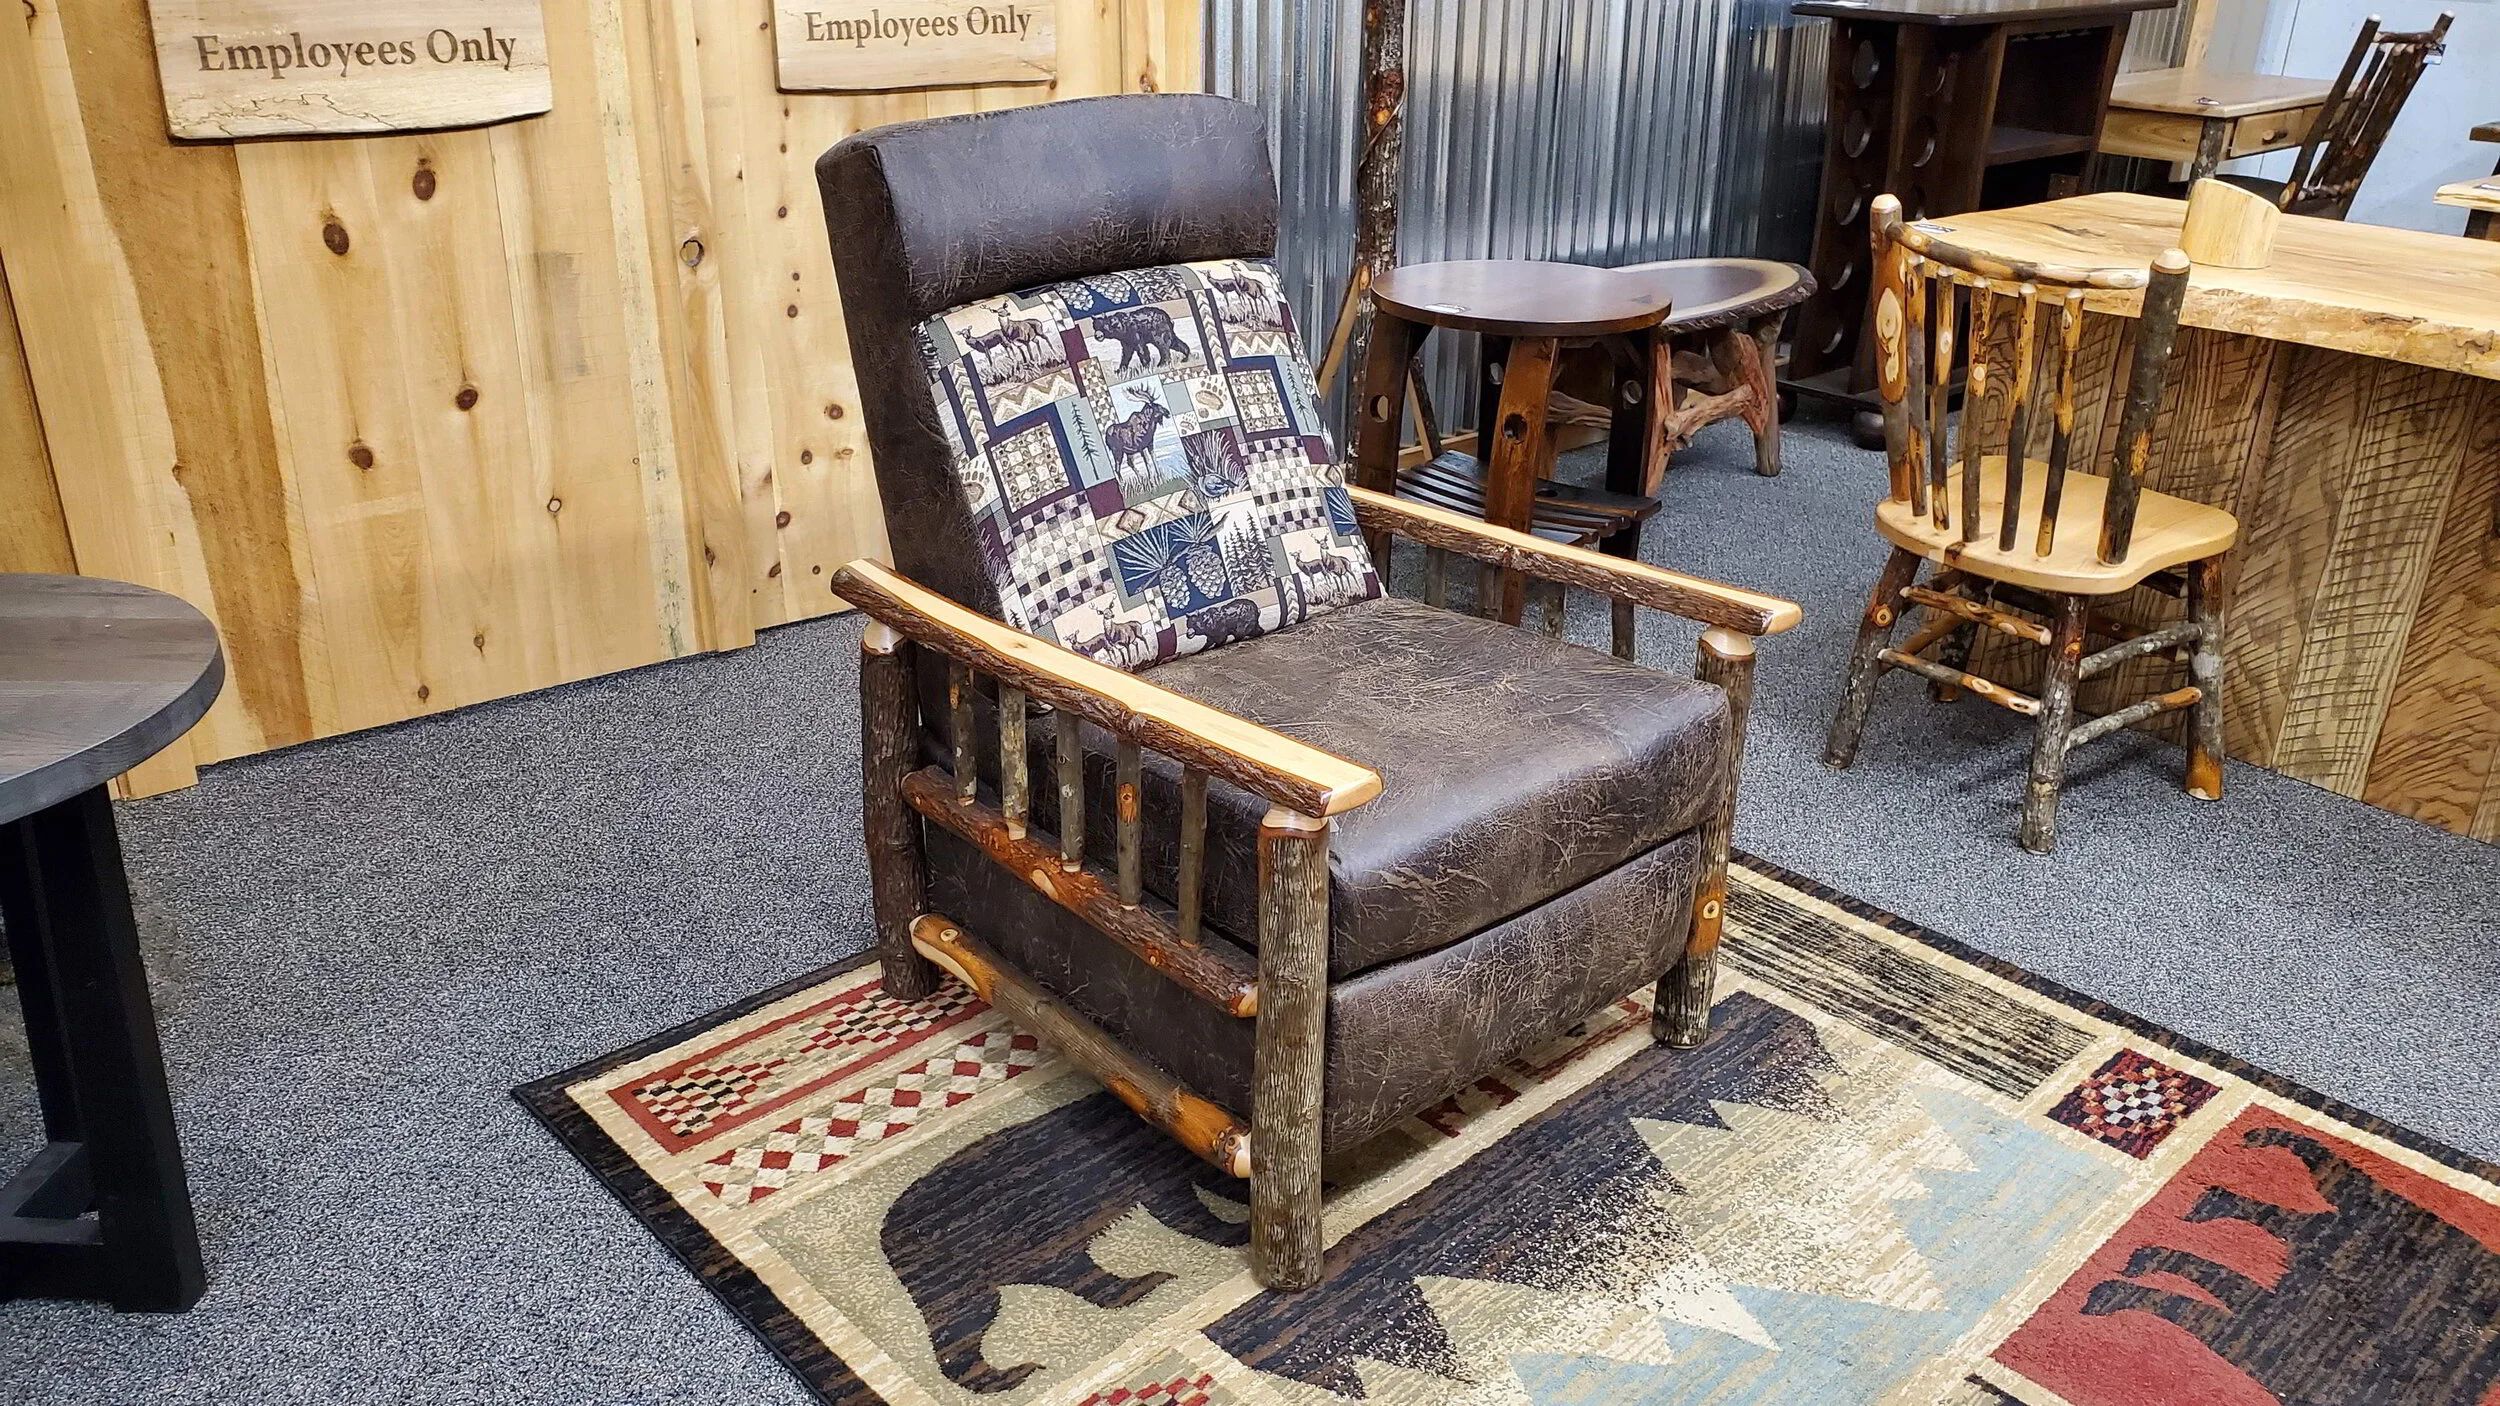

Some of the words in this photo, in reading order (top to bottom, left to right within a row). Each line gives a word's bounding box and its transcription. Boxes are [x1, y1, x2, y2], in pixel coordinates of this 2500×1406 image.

[805, 9, 959, 48] Employees
[966, 5, 1032, 41] Only
[193, 32, 417, 79] Employees
[426, 27, 516, 71] Only
